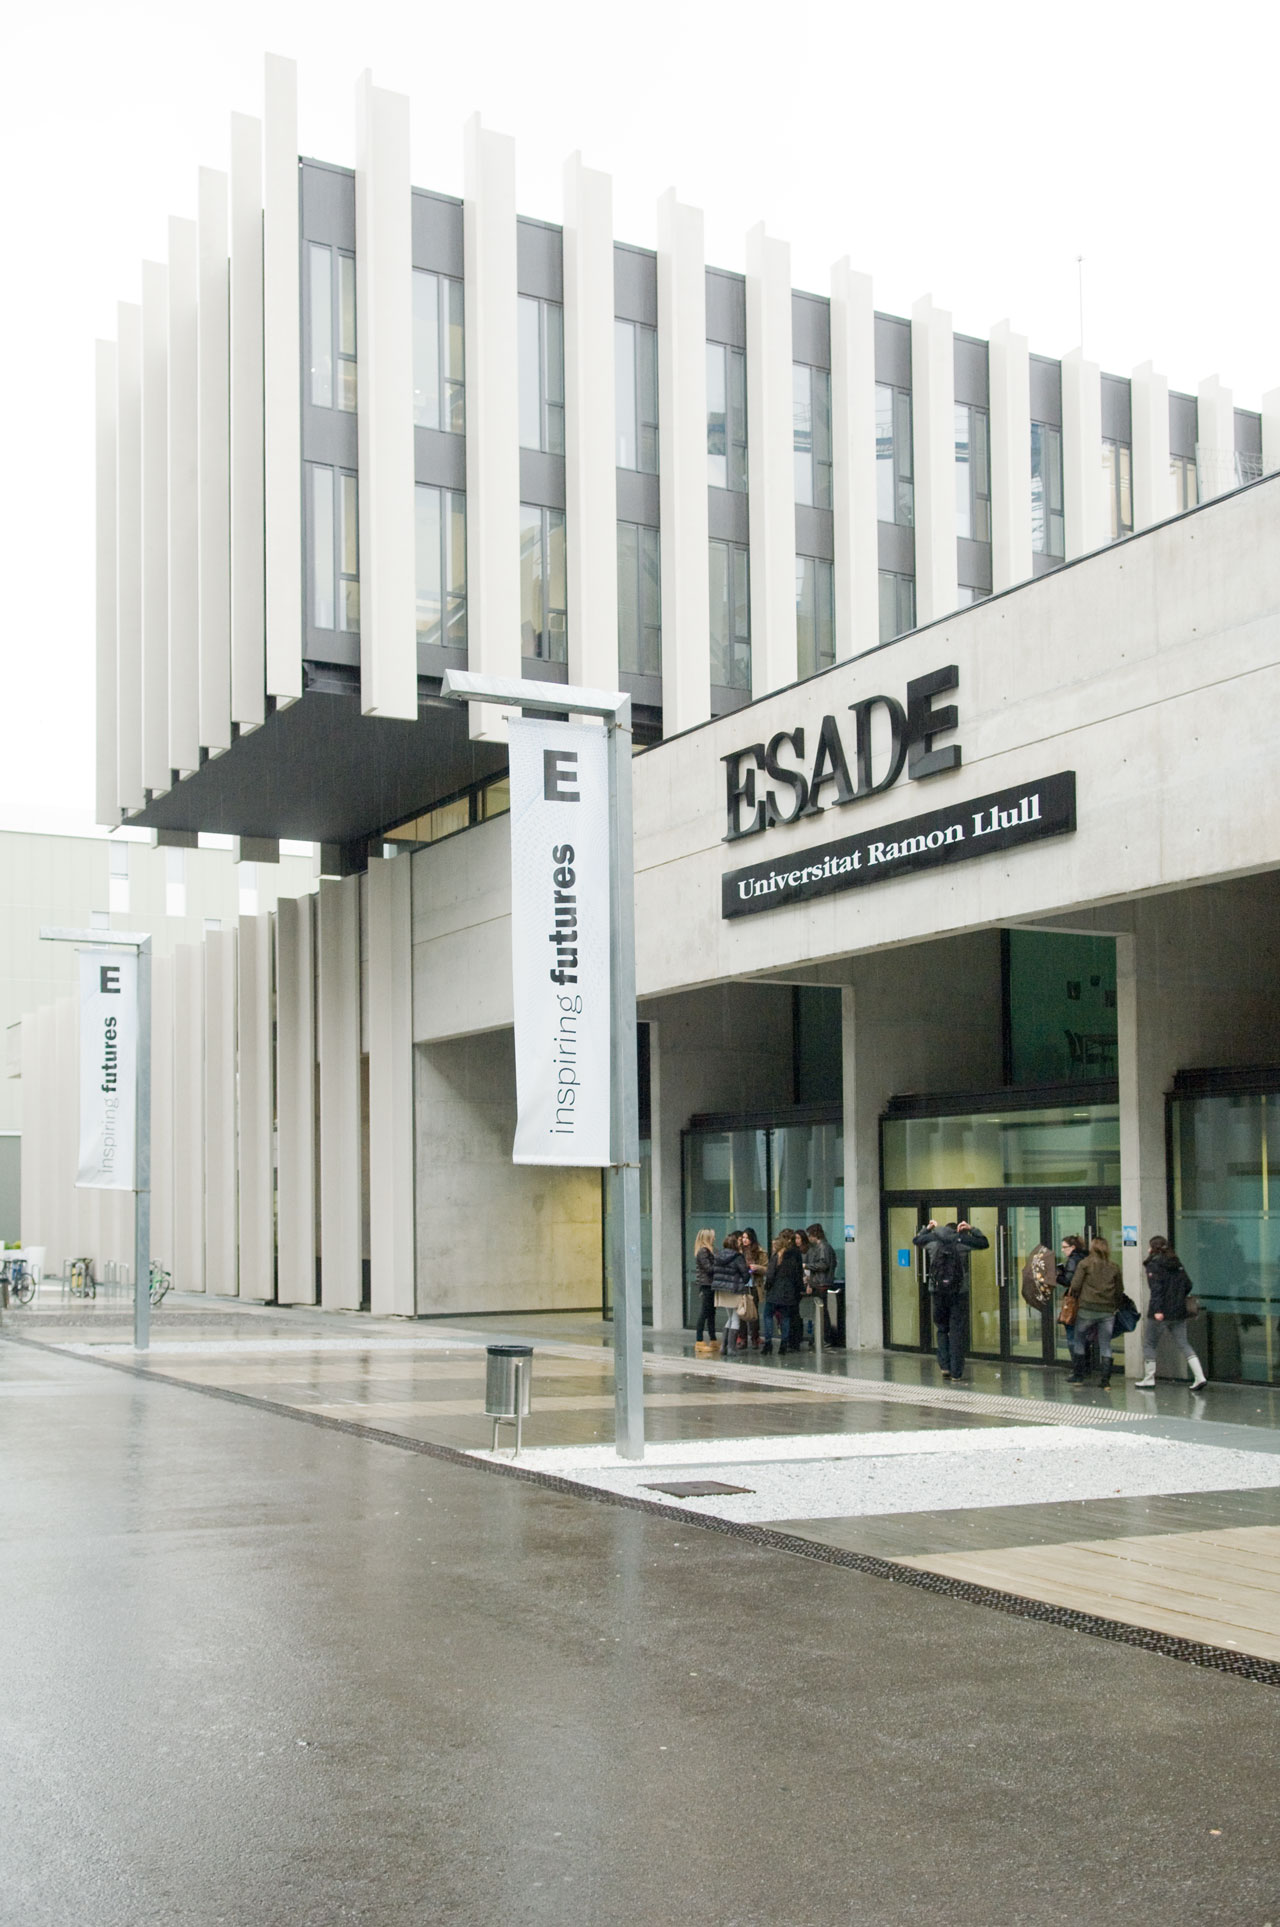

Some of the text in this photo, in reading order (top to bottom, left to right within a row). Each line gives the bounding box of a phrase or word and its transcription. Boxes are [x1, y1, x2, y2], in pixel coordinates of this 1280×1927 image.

[543, 749, 581, 802] E
[720, 664, 962, 842] ESADE
[738, 794, 1042, 899] Universitat Ramon Llull
[100, 965, 121, 994] E
[549, 843, 583, 1134] inspiring futures
[97, 1016, 120, 1174] inspiring futures
